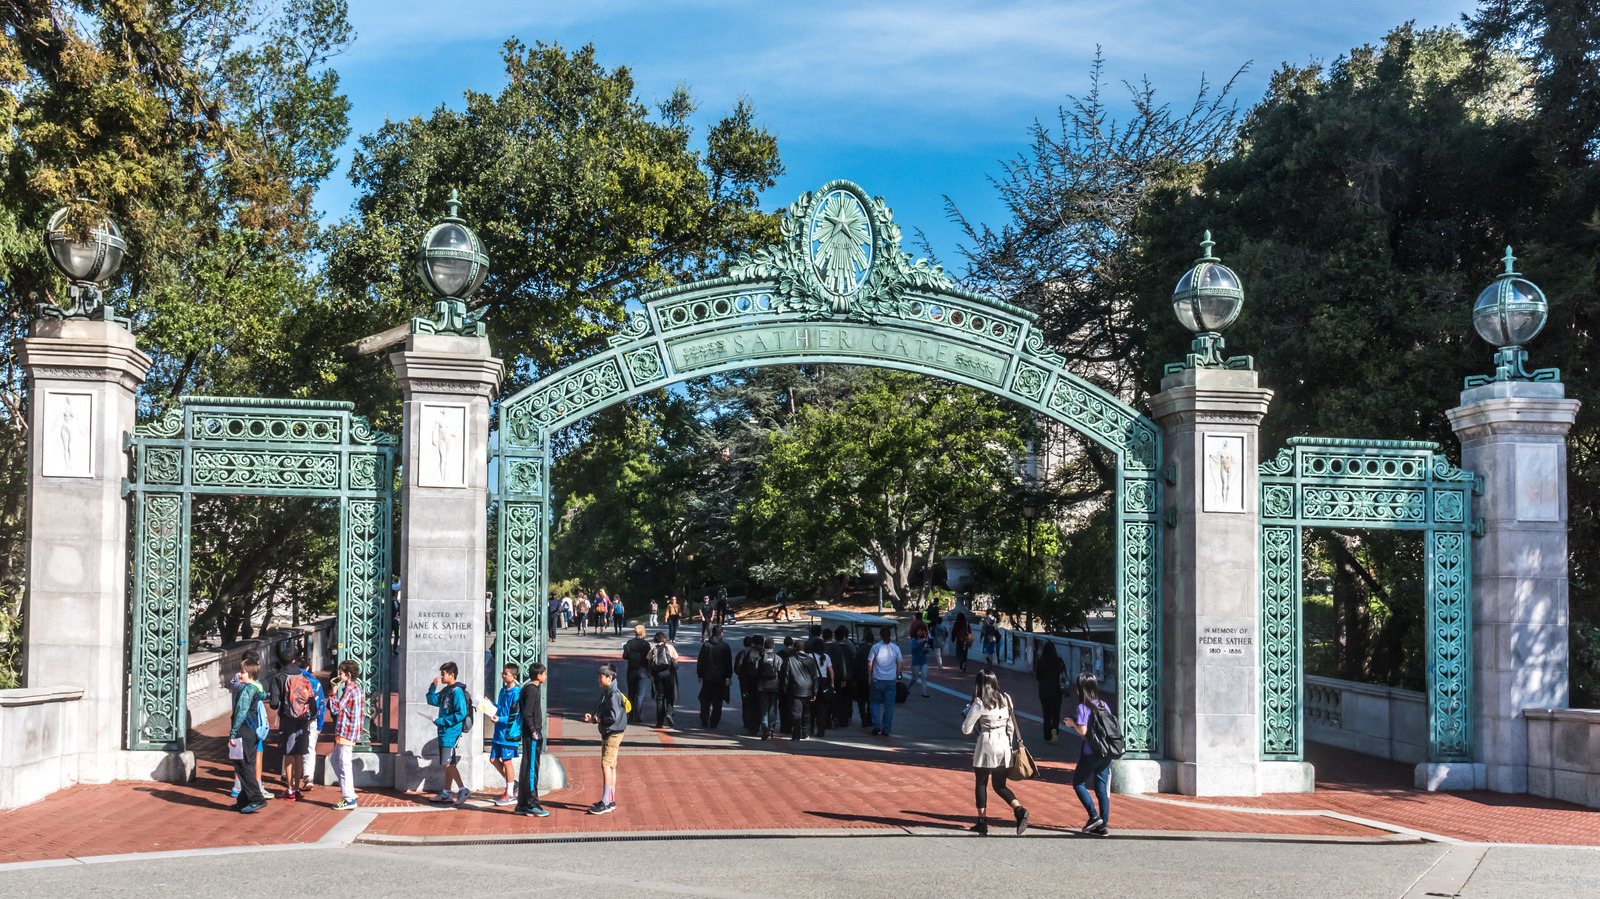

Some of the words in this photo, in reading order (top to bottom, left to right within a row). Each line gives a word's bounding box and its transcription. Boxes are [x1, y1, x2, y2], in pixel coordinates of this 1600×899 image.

[733, 328, 852, 354] SATHER
[871, 333, 949, 363] GATE
[408, 621, 430, 630] JANE
[442, 621, 472, 630] SATHER
[1198, 636, 1223, 645] PEDER
[1225, 637, 1253, 646] SATHER
